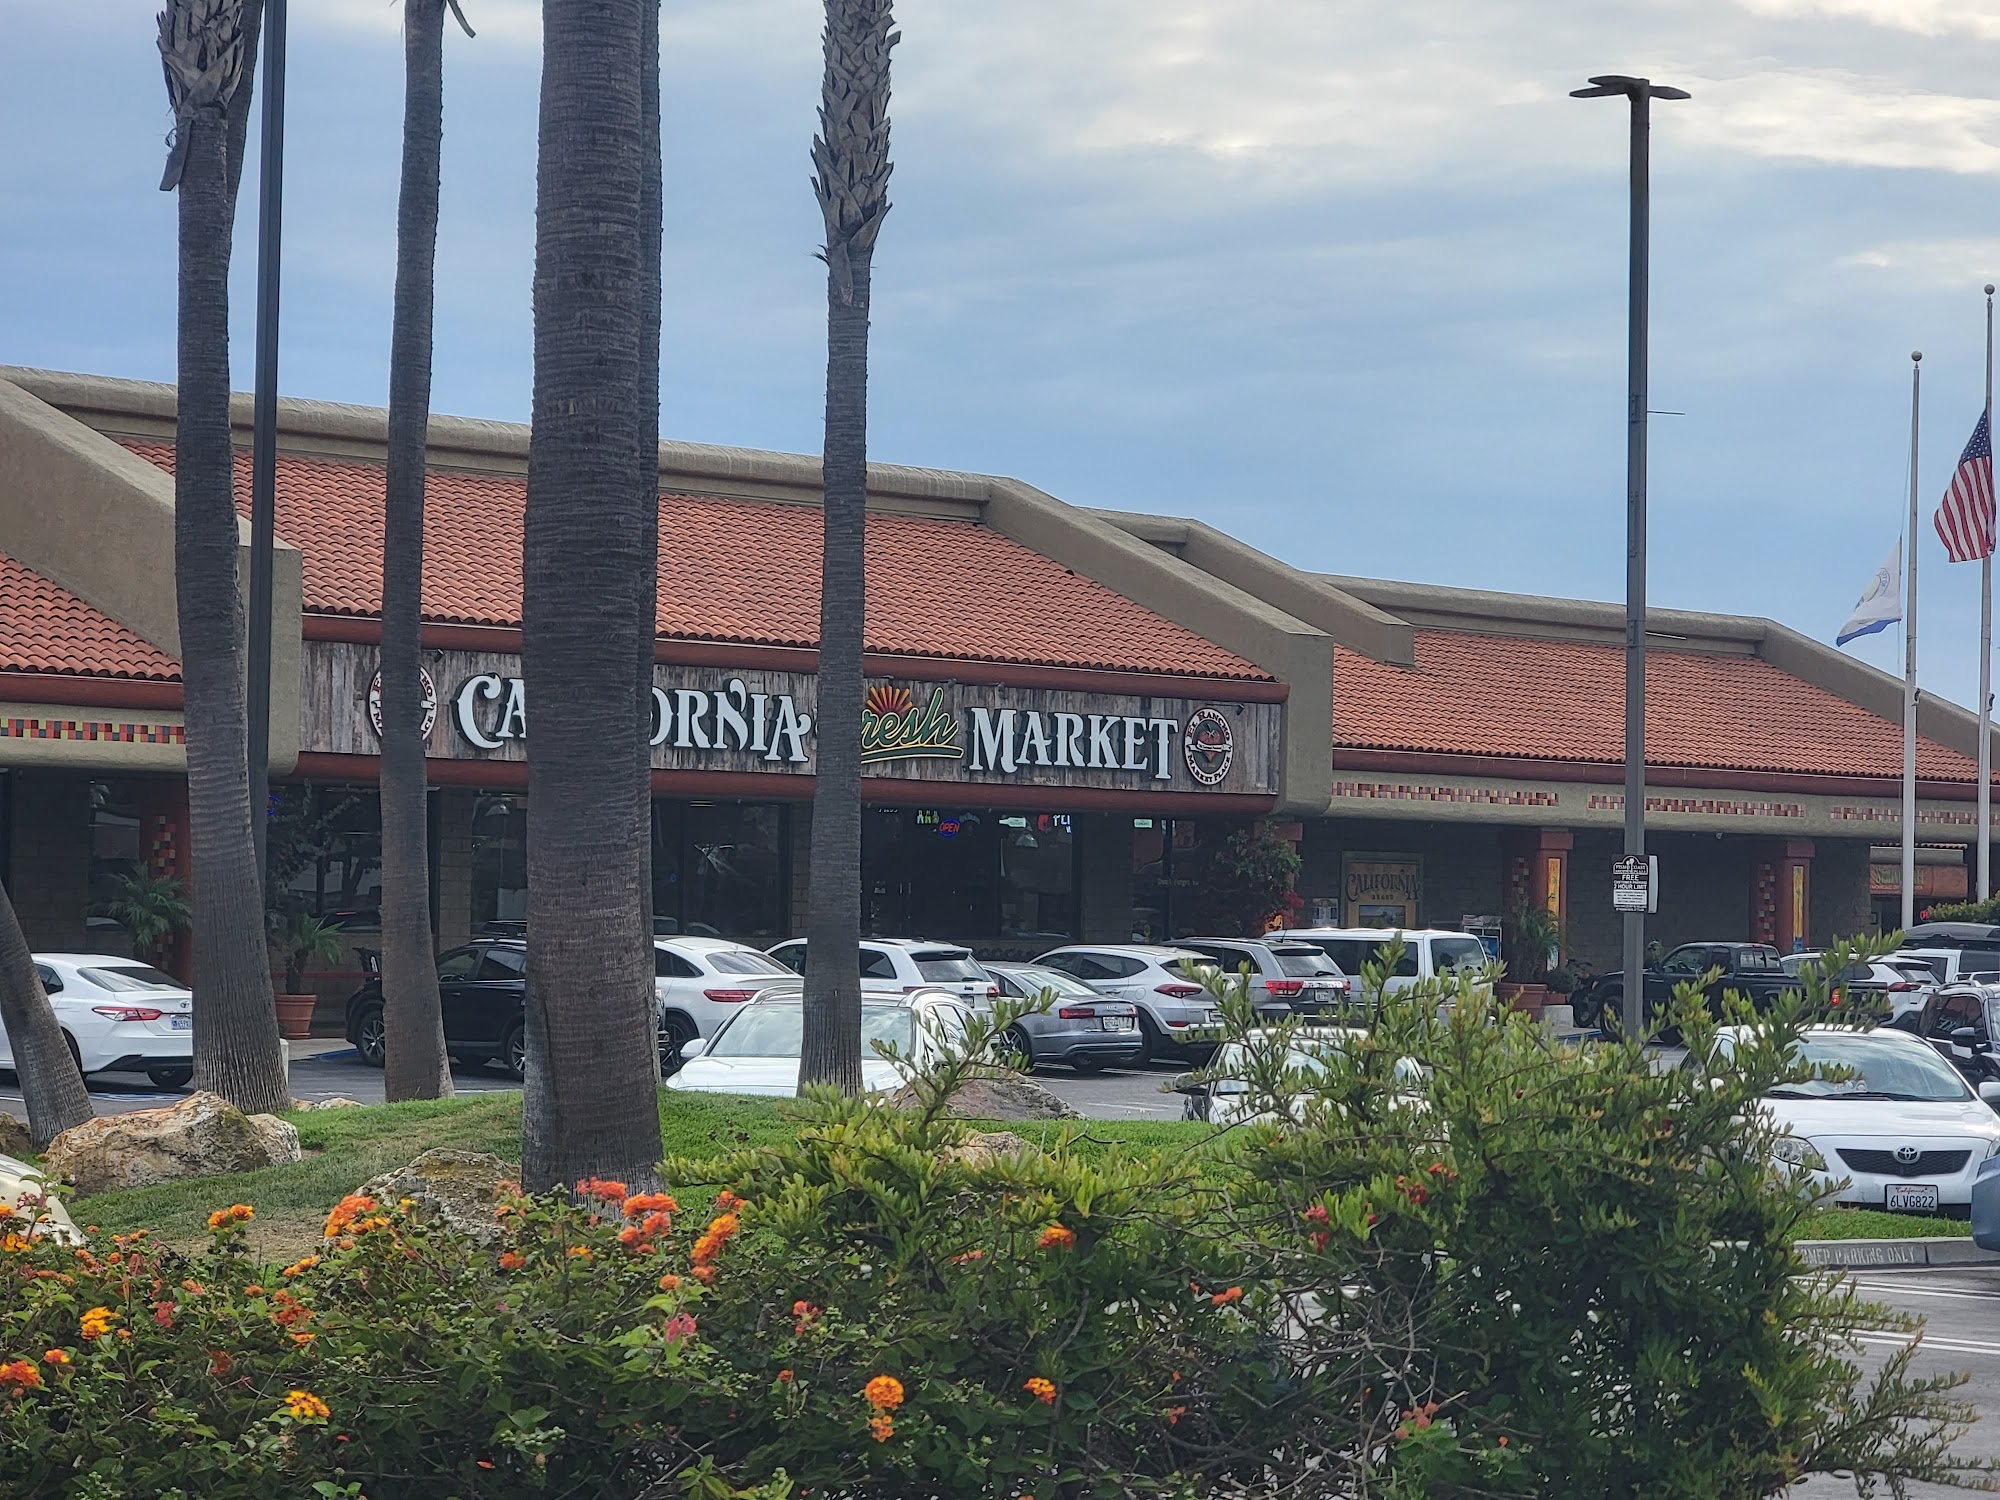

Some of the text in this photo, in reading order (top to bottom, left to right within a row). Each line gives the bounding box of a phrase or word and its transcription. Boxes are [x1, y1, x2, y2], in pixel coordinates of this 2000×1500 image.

[456, 673, 1179, 780] CAORNIA resh MARKET
[1187, 710, 1231, 742] EL RANCHO
[939, 822, 960, 833] OPEN
[1345, 868, 1421, 903] CALIFORNIA
[1890, 1195, 1935, 1208] 6LVG822
[1835, 1247, 1884, 1264] PARKING
[1887, 1245, 1916, 1262] ONLY
